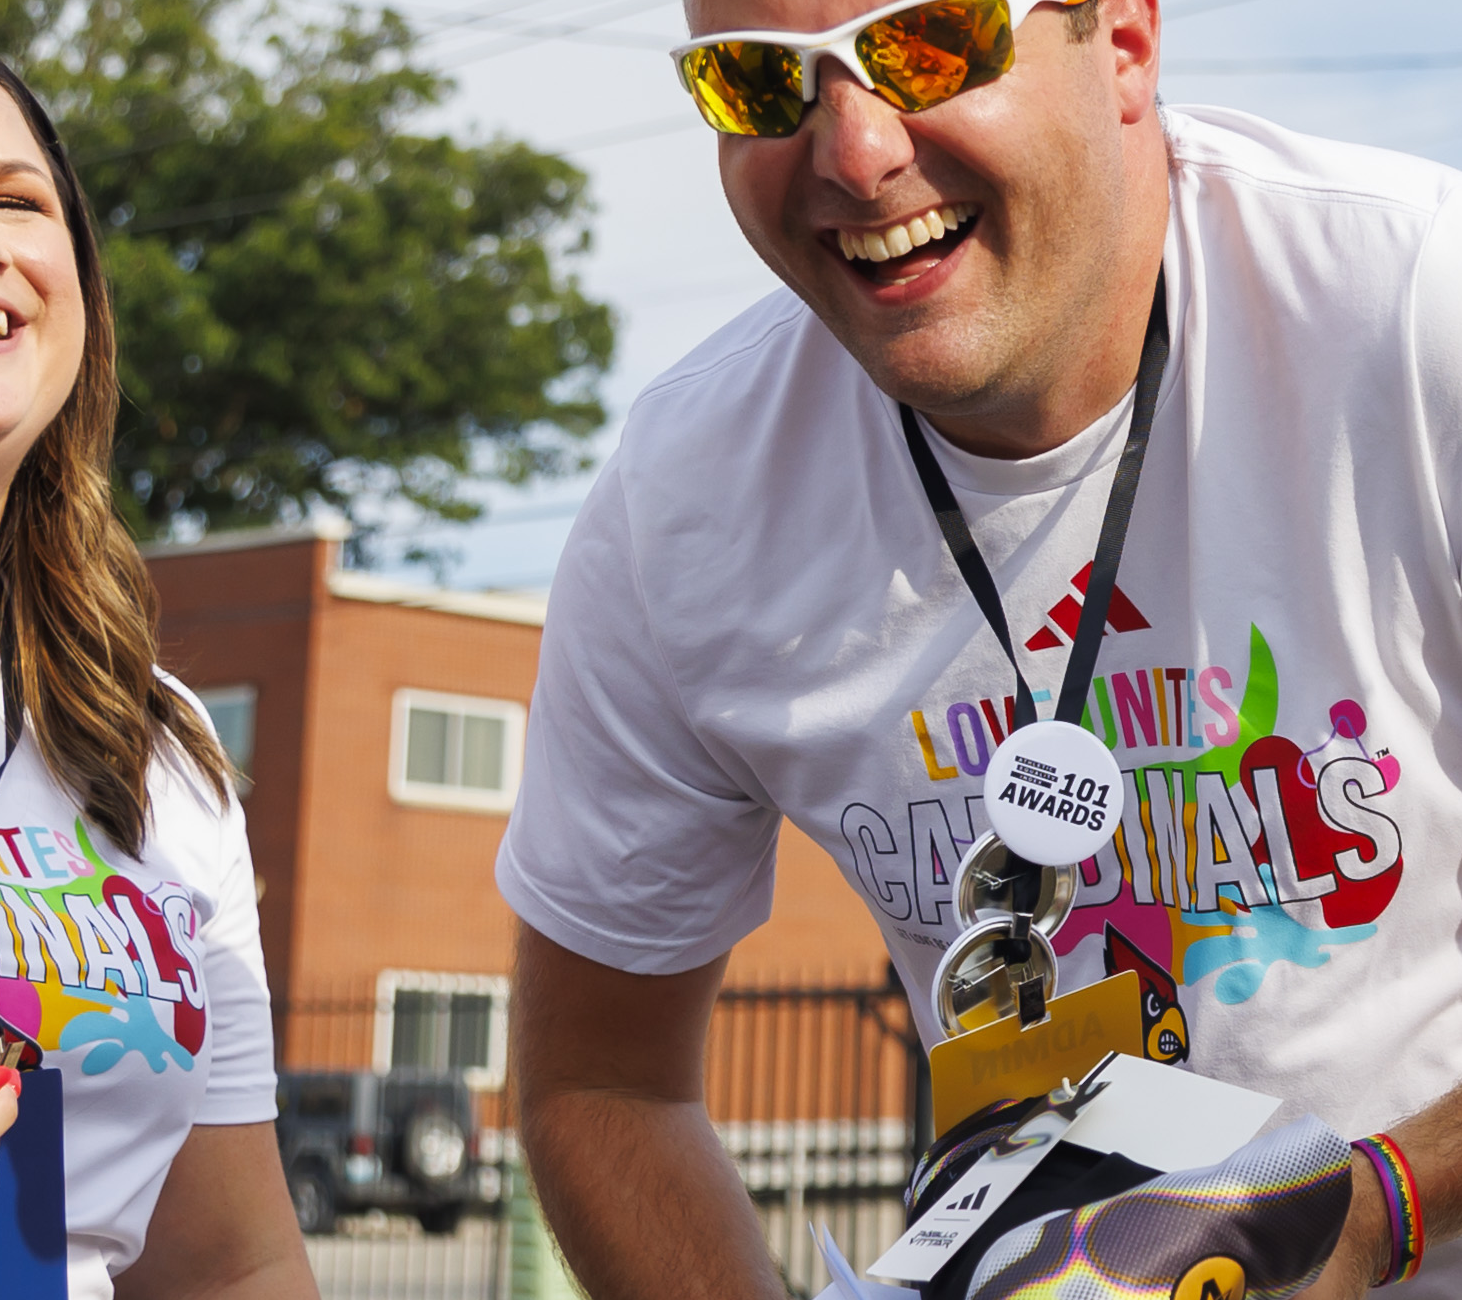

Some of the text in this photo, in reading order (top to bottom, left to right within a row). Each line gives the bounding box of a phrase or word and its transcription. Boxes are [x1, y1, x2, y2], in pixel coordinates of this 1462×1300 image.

[911, 688, 1052, 781] LOV
[1018, 756, 1054, 772] ATHLETIC
[1018, 766, 1056, 781] EQUALITY
[998, 782, 1106, 831] AWARDS
[1058, 773, 1110, 808] 101
